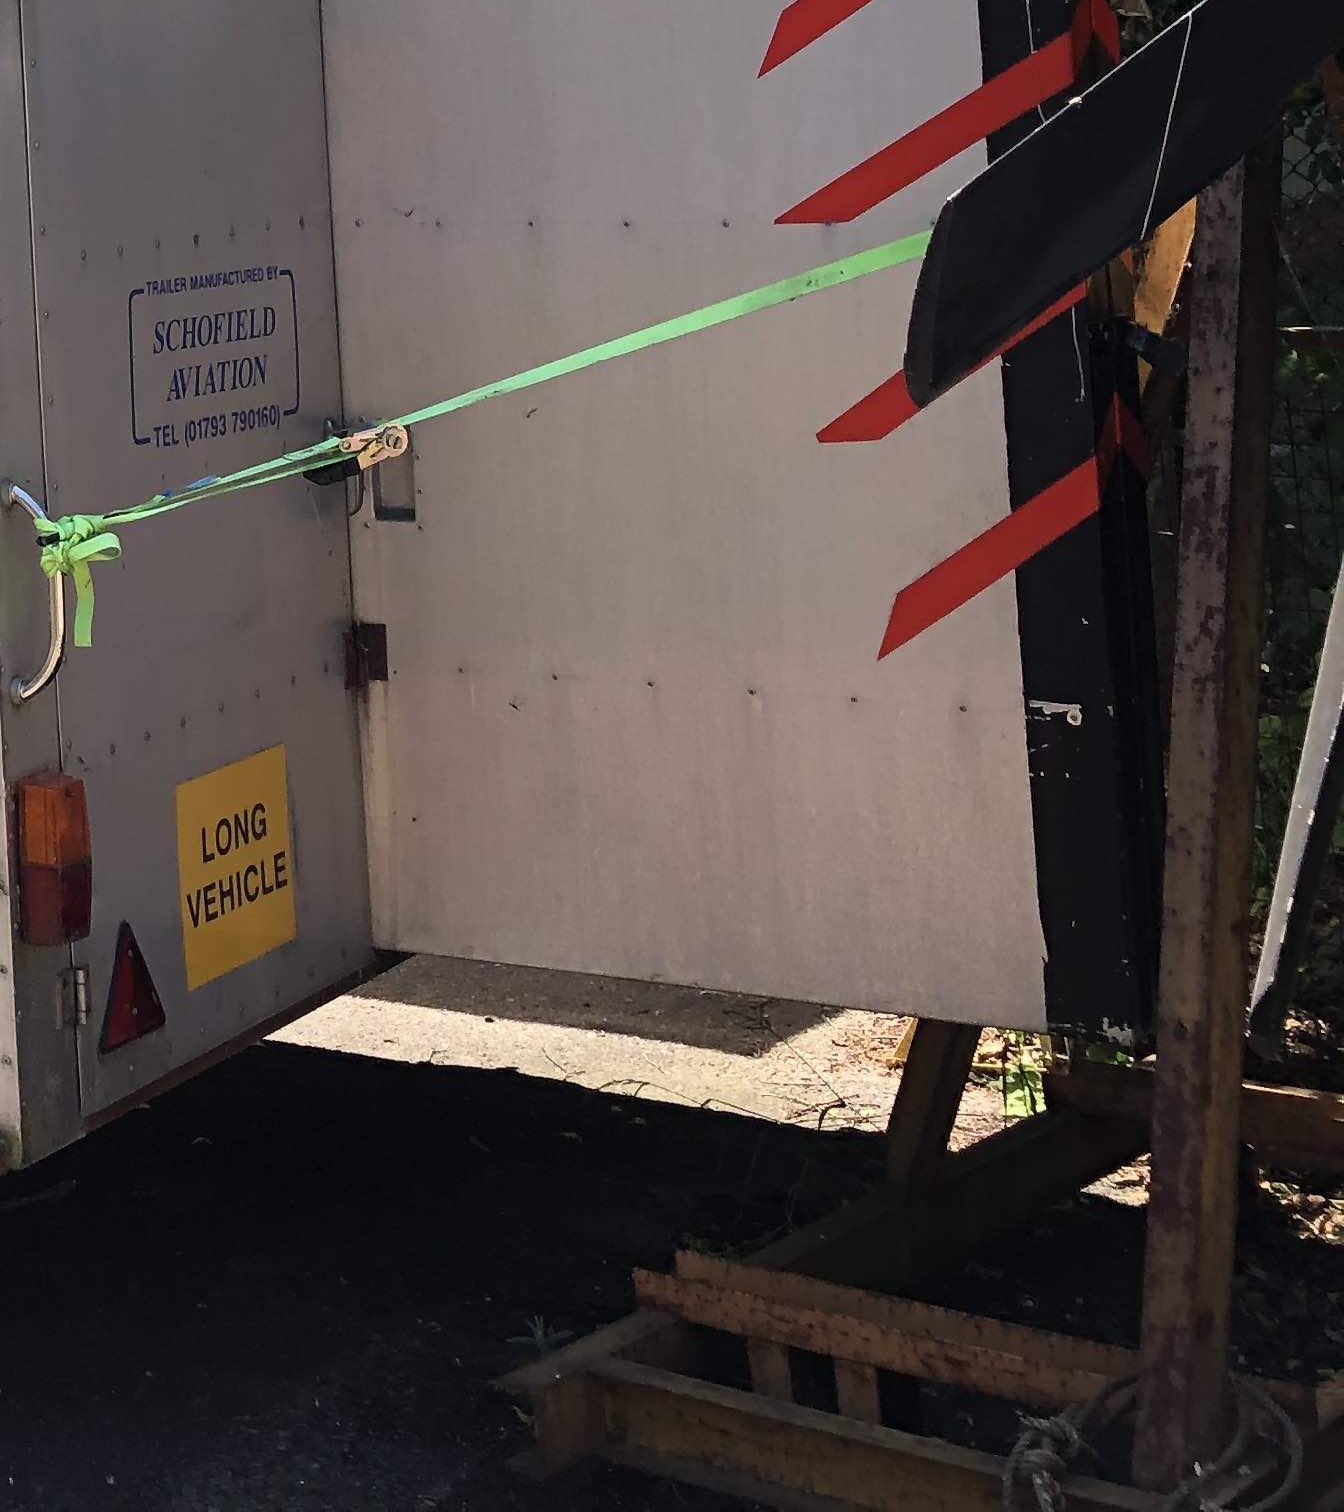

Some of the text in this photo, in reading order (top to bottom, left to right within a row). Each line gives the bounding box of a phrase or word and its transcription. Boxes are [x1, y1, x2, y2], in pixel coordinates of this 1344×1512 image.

[146, 265, 279, 296] TRAILER MANUFACTURED BY
[153, 306, 276, 354] SCHOFIELD
[166, 355, 268, 402] AVIATION
[153, 405, 280, 448] TEL (01793 790160)
[201, 803, 268, 863] LONG
[186, 851, 288, 928] VEHICLE
